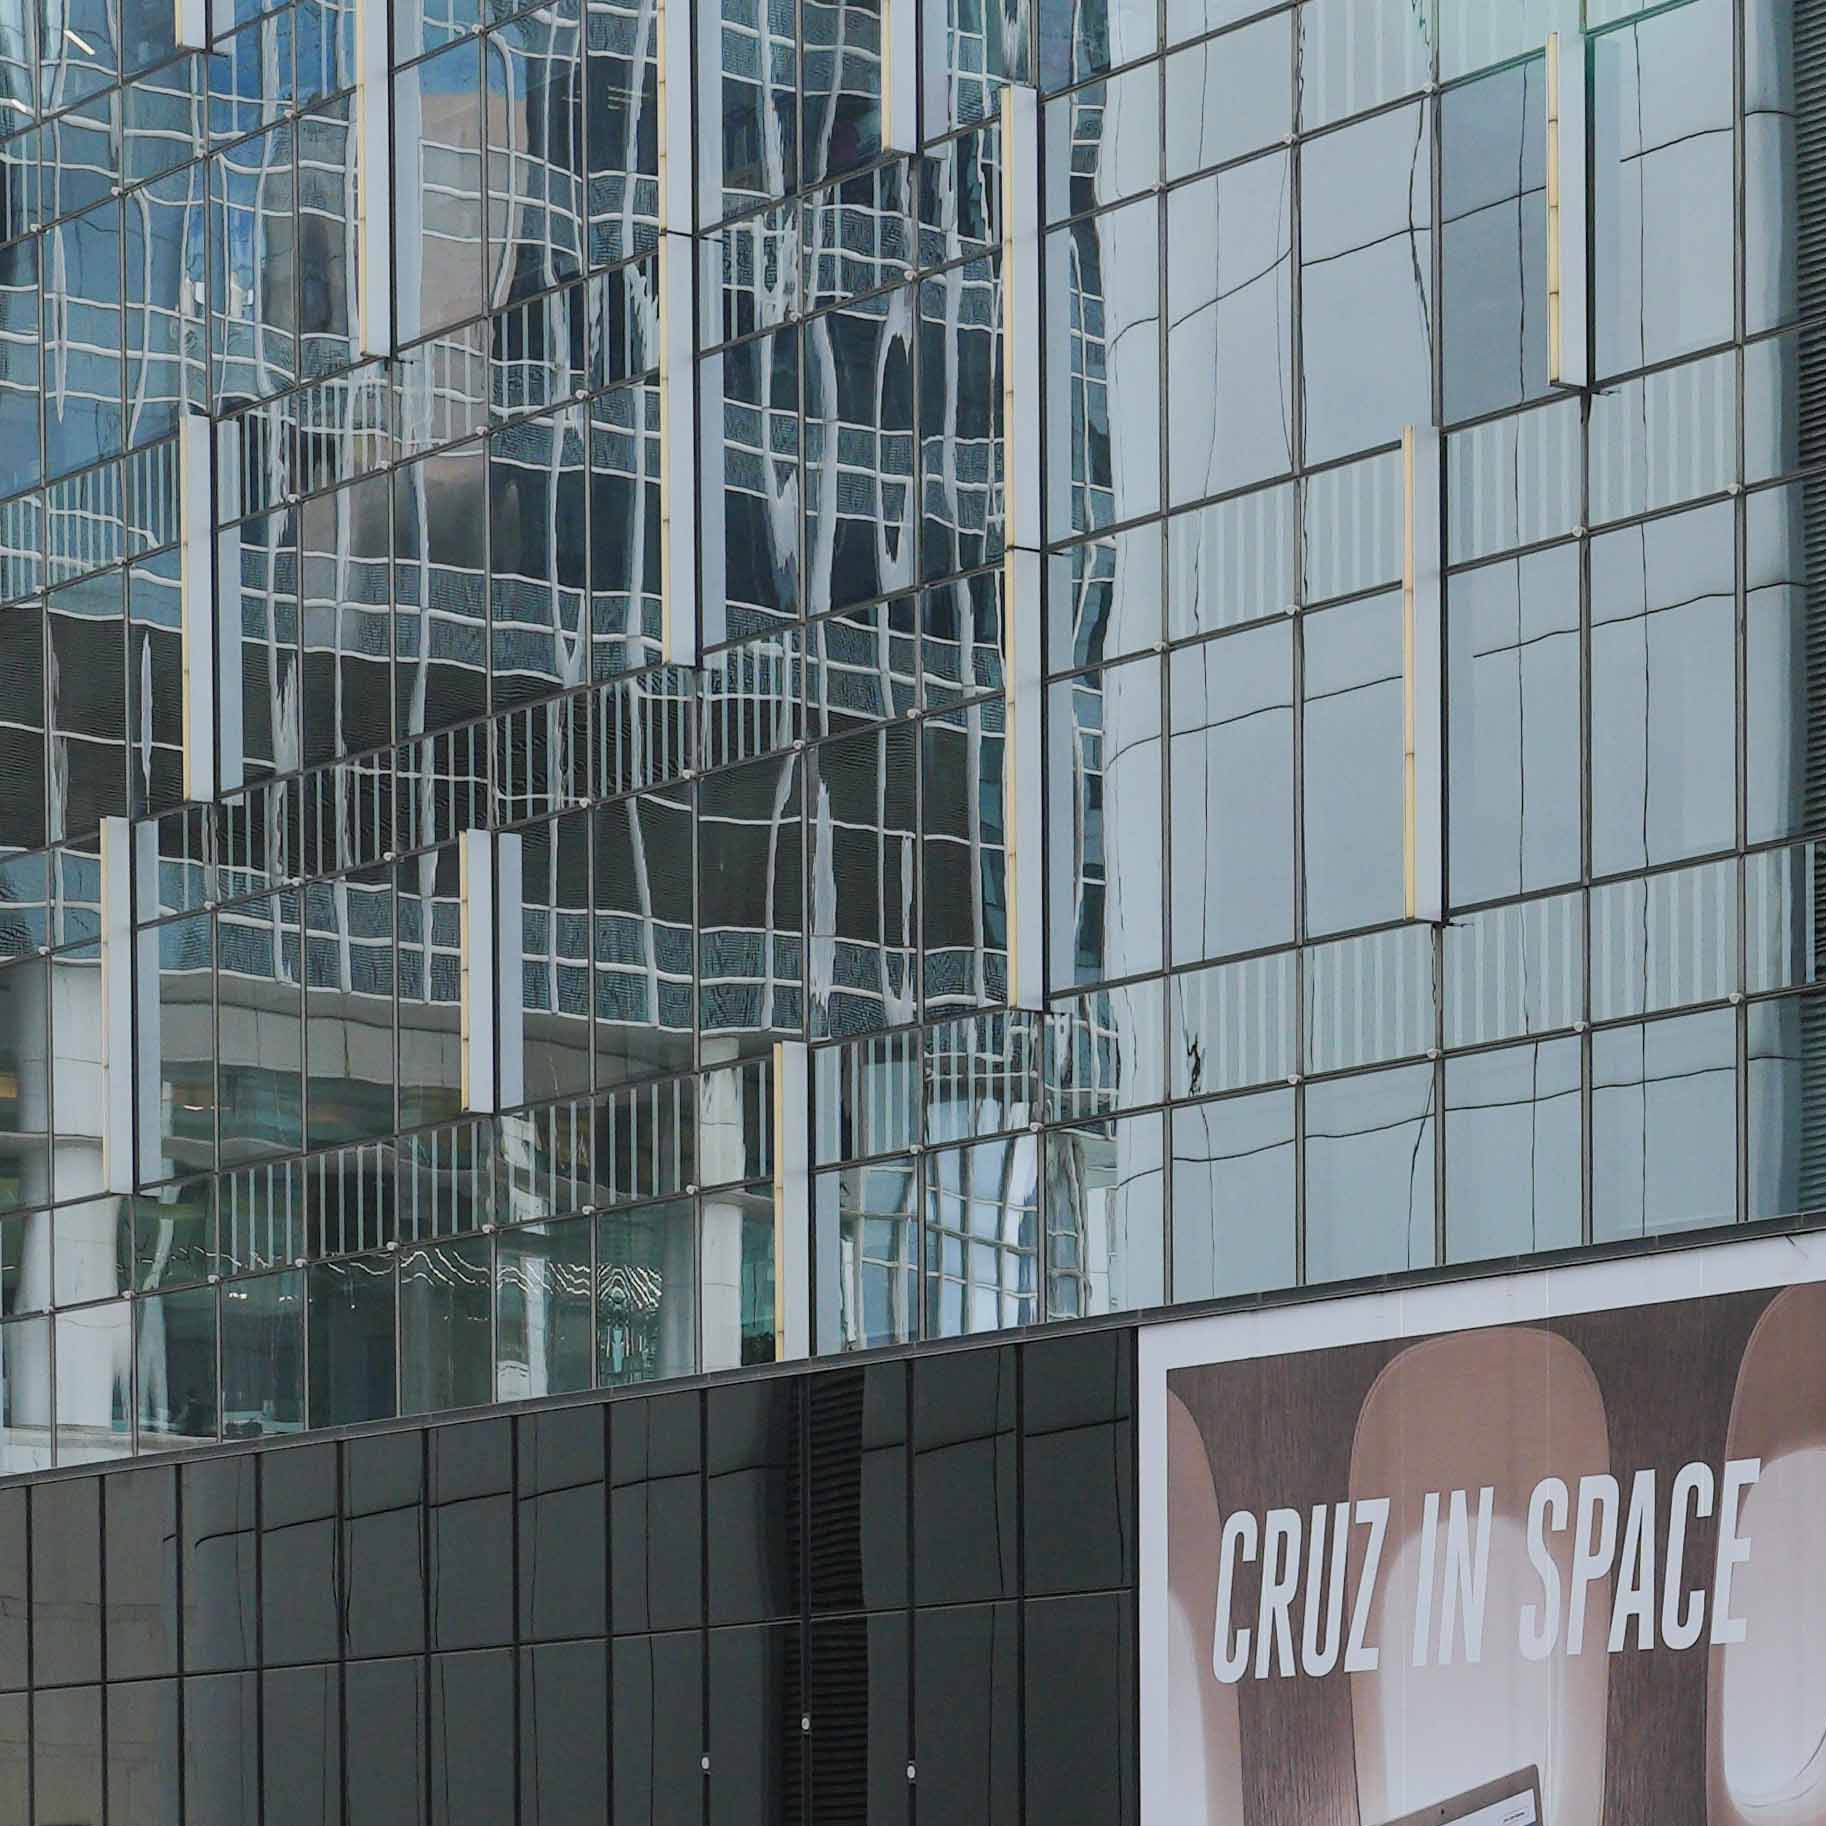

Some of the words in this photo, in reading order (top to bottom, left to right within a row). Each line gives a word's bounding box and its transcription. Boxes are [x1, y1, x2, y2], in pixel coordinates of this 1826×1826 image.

[1212, 1498, 1390, 1684] CRUZ
[1411, 1486, 1495, 1668] IN
[1518, 1457, 1762, 1663] SPACE
